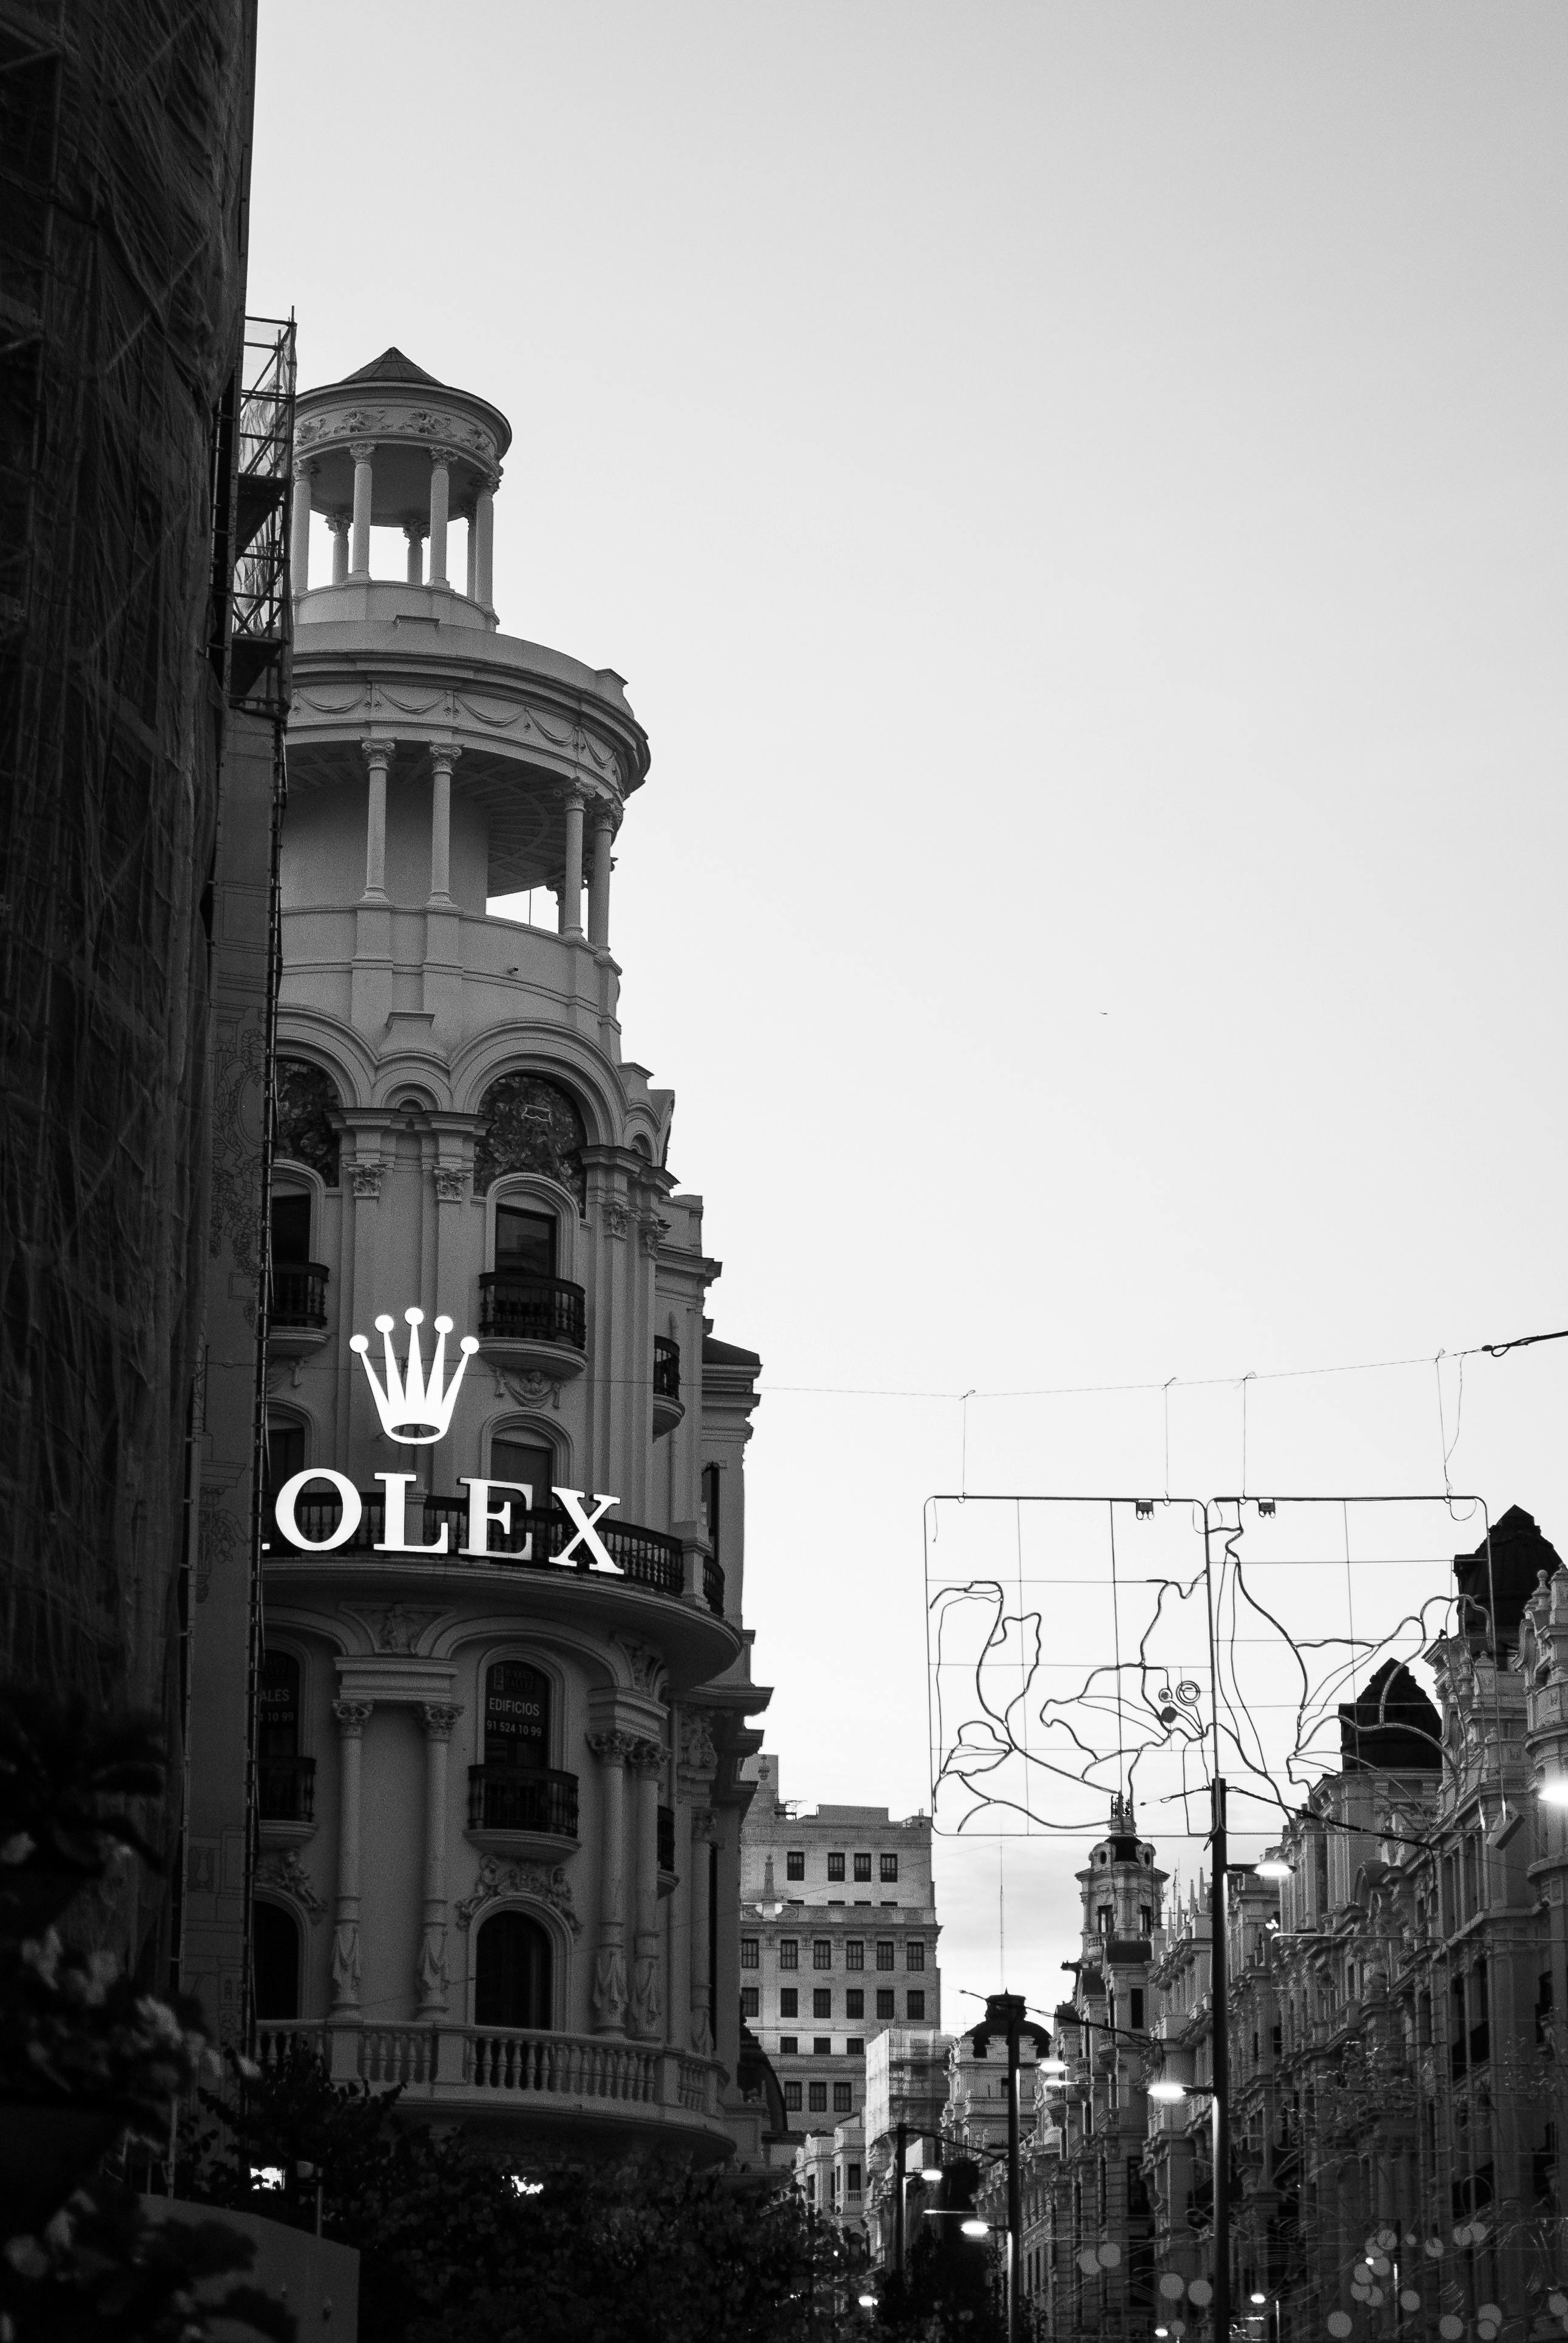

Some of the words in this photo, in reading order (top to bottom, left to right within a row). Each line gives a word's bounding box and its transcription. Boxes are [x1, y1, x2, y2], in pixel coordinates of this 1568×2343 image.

[262, 1468, 624, 1575] OLEX
[261, 1689, 289, 1702] ALES
[489, 1697, 539, 1716] EDIFICIOS
[268, 1712, 279, 1722] 10
[281, 1711, 294, 1721] 99
[487, 1720, 496, 1731] 91
[500, 1721, 516, 1734] 524
[519, 1724, 529, 1735] 10
[531, 1726, 542, 1737] 99
